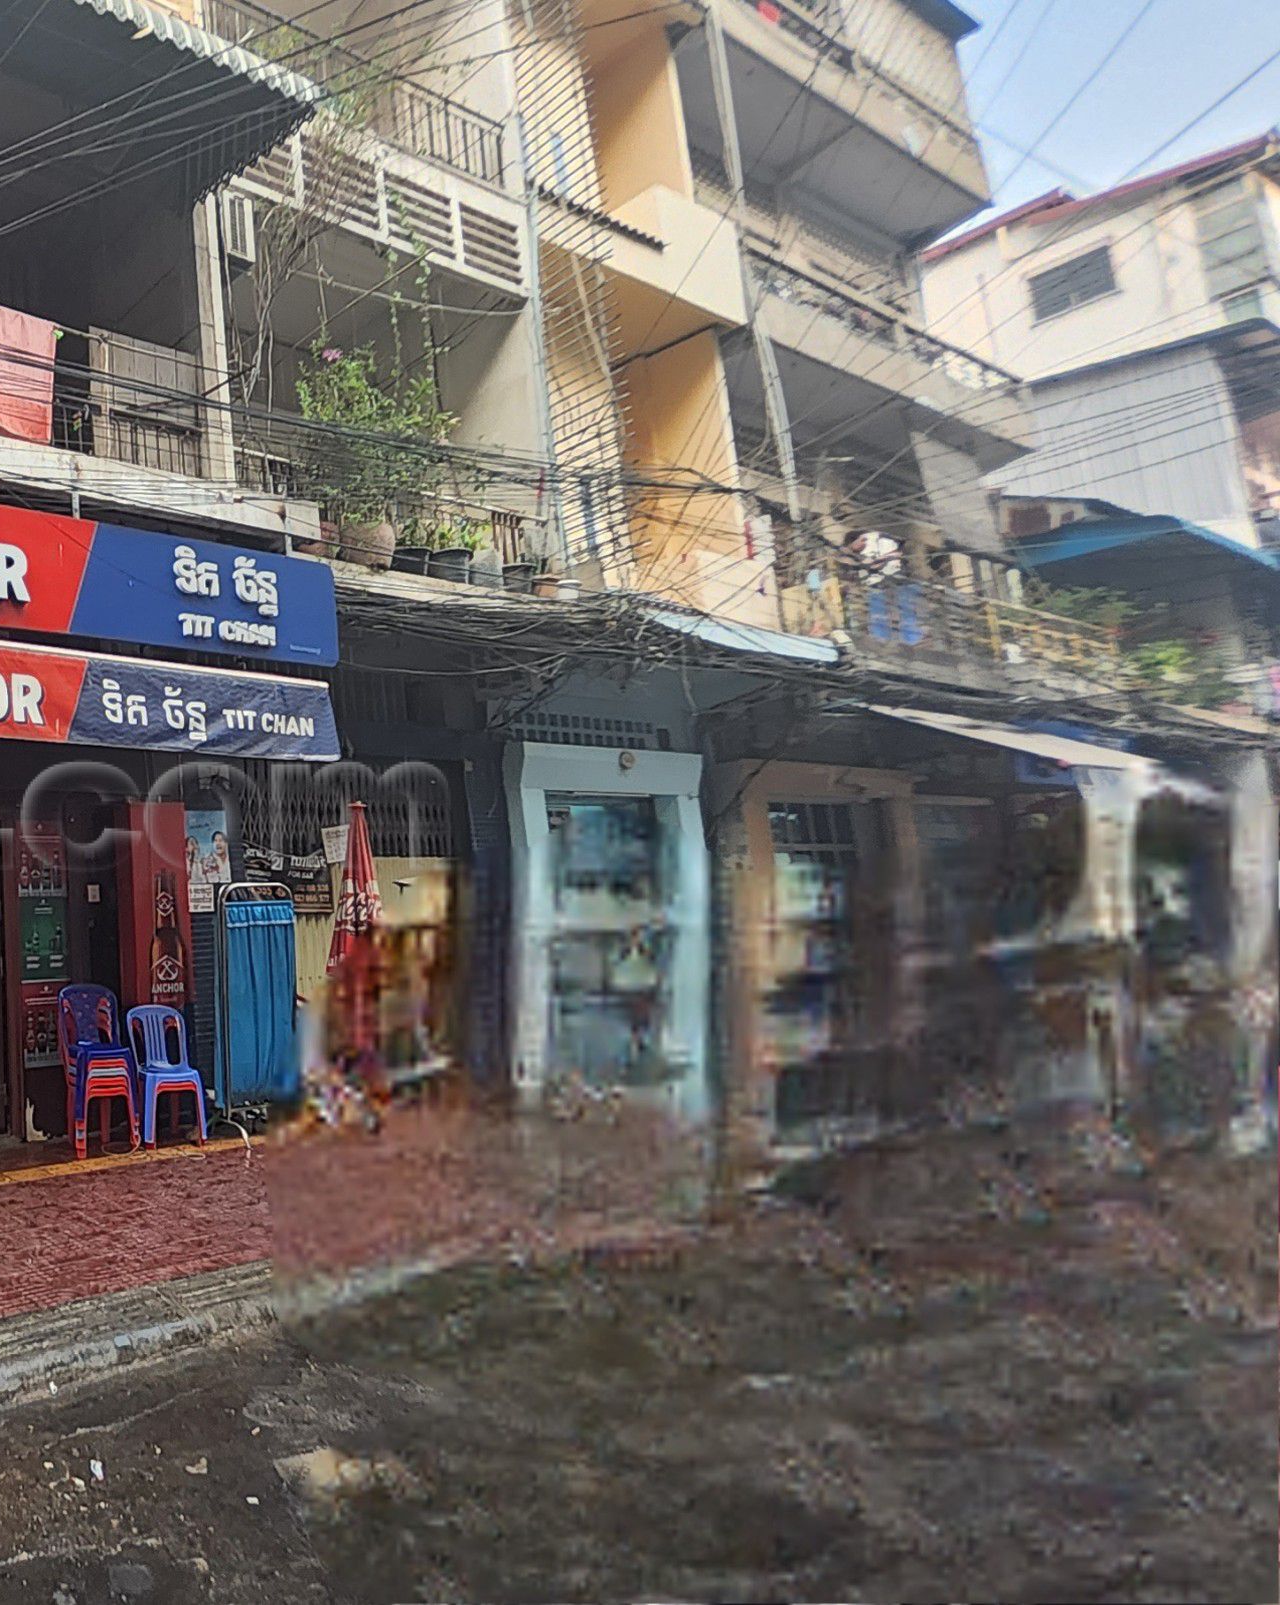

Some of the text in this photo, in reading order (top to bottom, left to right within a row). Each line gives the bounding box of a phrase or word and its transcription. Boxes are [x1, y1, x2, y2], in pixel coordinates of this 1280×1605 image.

[178, 613, 277, 647] TIT CHAN
[222, 709, 257, 731] TIT
[261, 713, 315, 738] CHAN
[151, 982, 185, 993] ANCHOR
